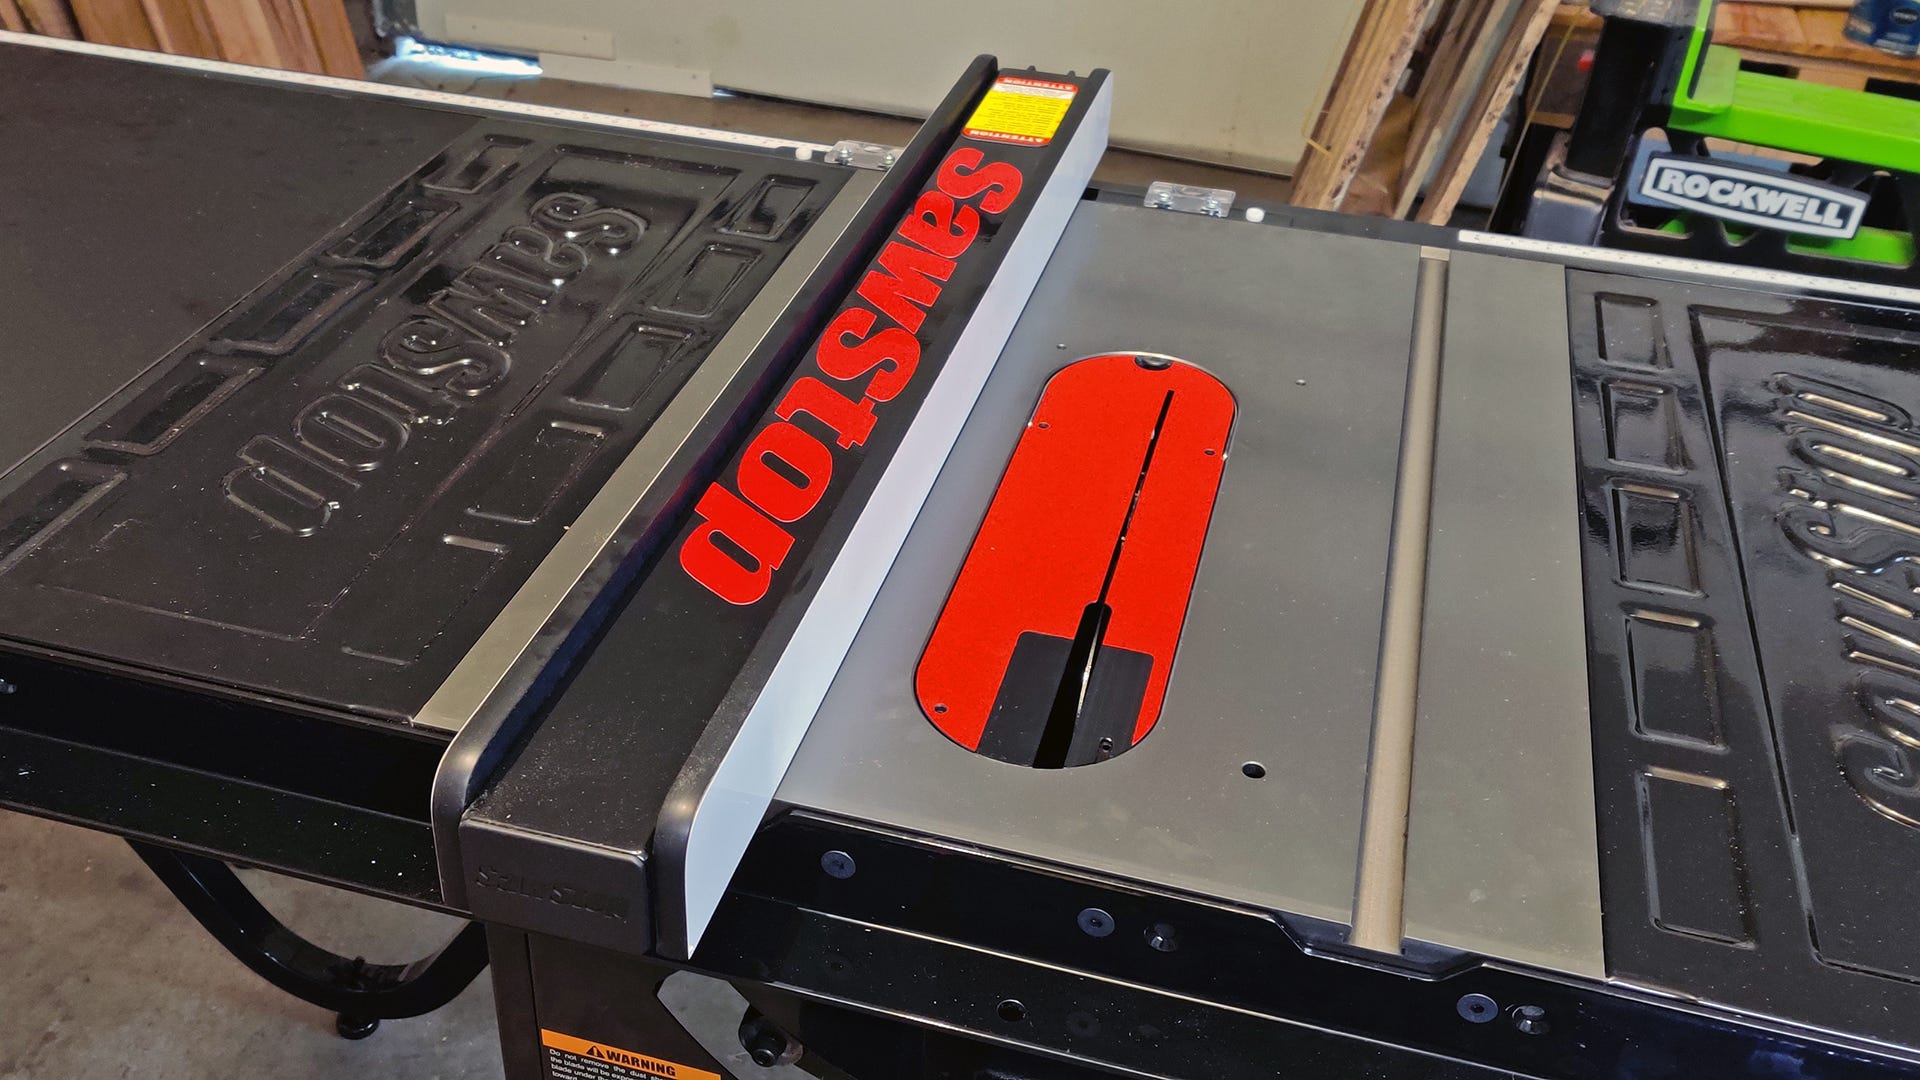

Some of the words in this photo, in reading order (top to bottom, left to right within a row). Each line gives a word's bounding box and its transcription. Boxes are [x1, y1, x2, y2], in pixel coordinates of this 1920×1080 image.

[1003, 76, 1073, 90] ATTENTION
[969, 129, 1044, 143] ATTENTION
[1658, 167, 1845, 229] ROCKWELL
[679, 147, 1023, 606] SawStop
[549, 1048, 561, 1057] Do
[564, 1053, 577, 1061] not
[580, 1057, 610, 1069] remove
[613, 1065, 626, 1074] the
[629, 1070, 647, 1079] dust
[550, 1056, 563, 1064] the
[563, 1059, 585, 1070] blade
[586, 1066, 599, 1074] will
[599, 1069, 610, 1077] be
[551, 1063, 572, 1074] blade
[573, 1069, 596, 1080] under
[606, 1050, 676, 1077] WARNING
